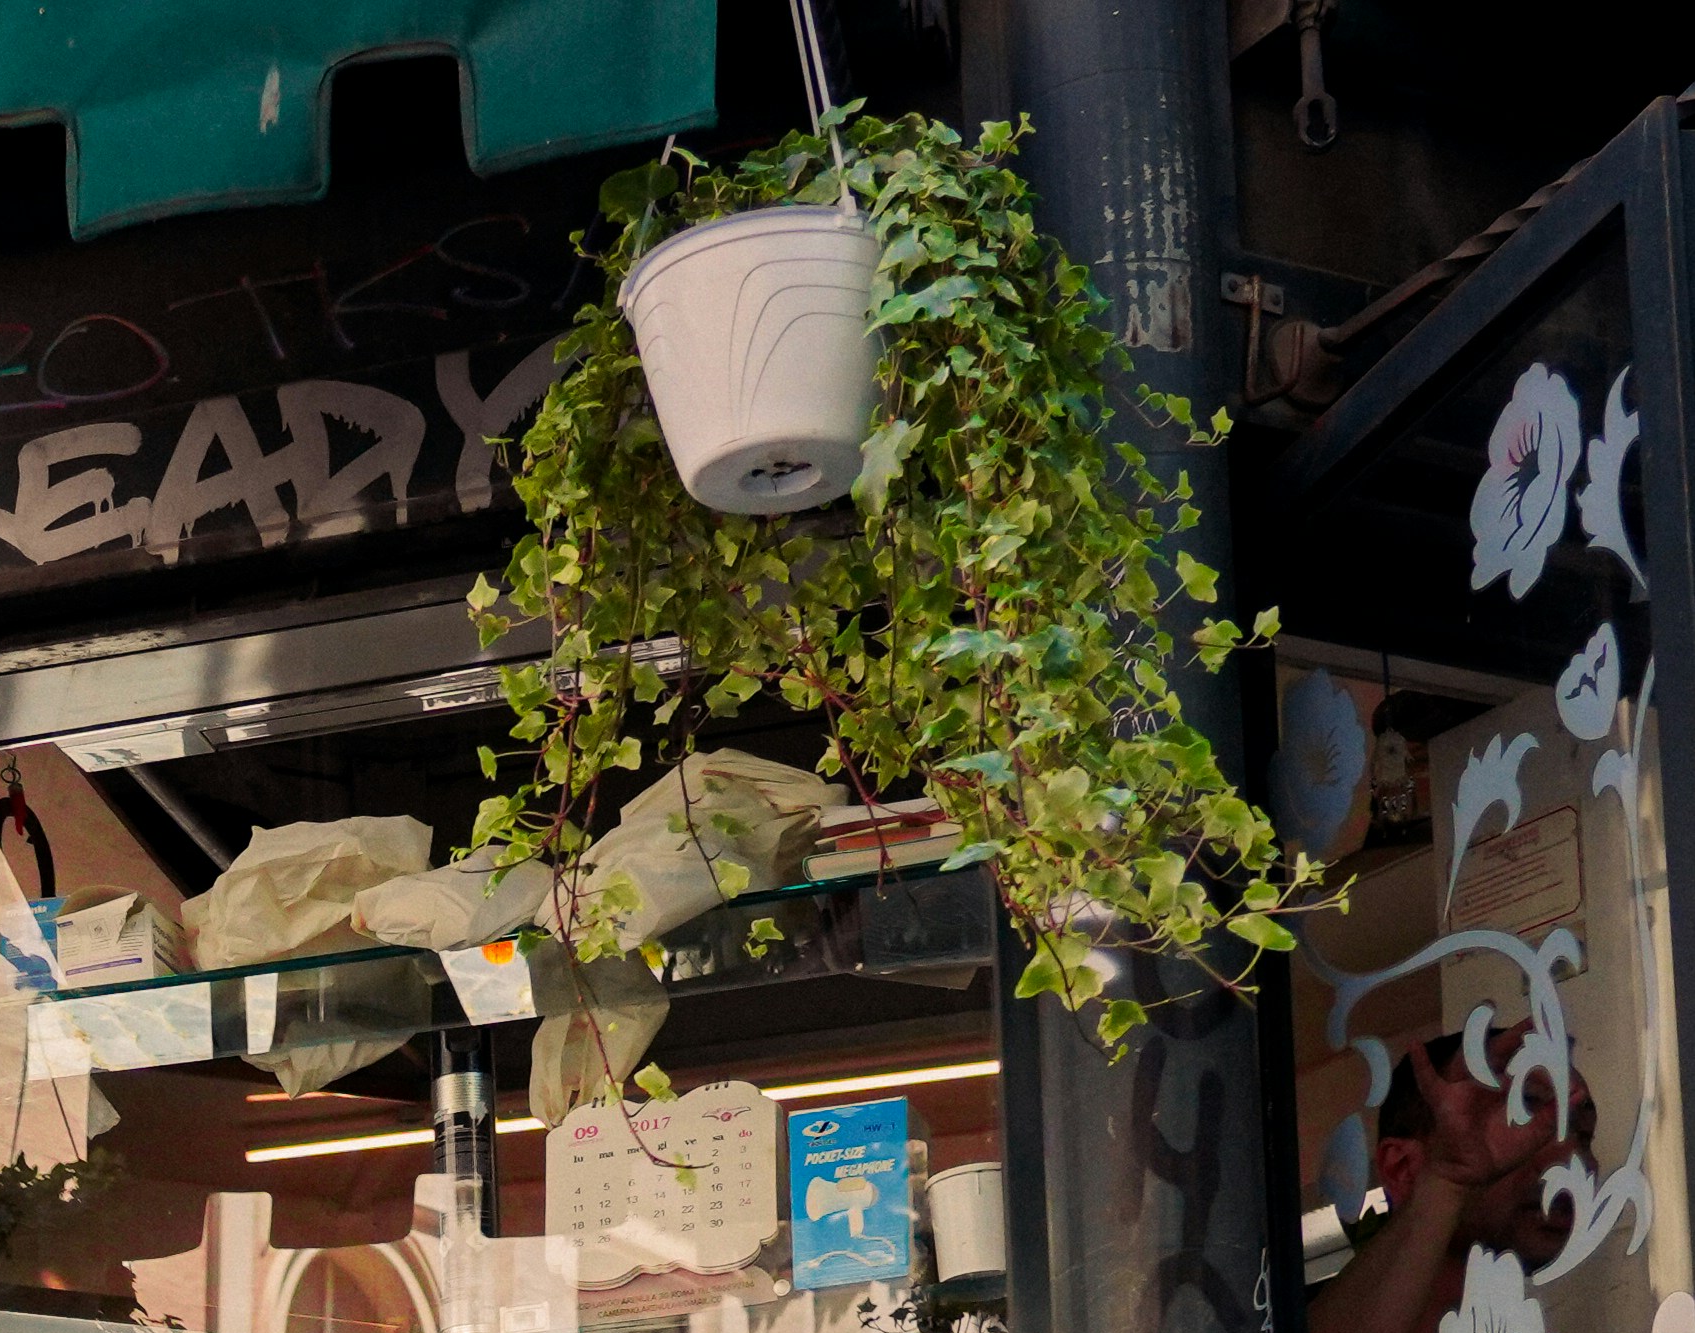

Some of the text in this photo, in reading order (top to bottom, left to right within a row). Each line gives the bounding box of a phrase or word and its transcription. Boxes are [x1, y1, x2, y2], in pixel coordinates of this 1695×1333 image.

[574, 1116, 671, 1140] 09 2017
[573, 1154, 584, 1164] lu
[599, 1150, 614, 1159] ma
[657, 1141, 668, 1151] gi
[684, 1137, 697, 1146] ve
[712, 1133, 724, 1142] sa
[738, 1129, 753, 1138] do
[712, 1149, 719, 1158] 2
[804, 1145, 866, 1166] POCKET-SIZE
[575, 1187, 581, 1196] 4
[603, 1182, 610, 1192] 5
[713, 1165, 720, 1175] 9
[740, 1162, 752, 1171] 10
[834, 1159, 896, 1179] MEGAPHONE
[573, 1204, 584, 1213] 11
[599, 1200, 611, 1209] 12
[626, 1195, 638, 1204] 13
[655, 1191, 666, 1200] 14
[711, 1183, 723, 1192] 16
[740, 1179, 752, 1188] 17
[572, 1221, 585, 1230] 18
[599, 1217, 611, 1226] 19
[653, 1209, 666, 1218] 21
[681, 1205, 694, 1214] 22
[710, 1200, 723, 1210] 23
[738, 1197, 752, 1206] 24
[572, 1238, 585, 1247] 25
[597, 1234, 611, 1243] 26
[681, 1222, 695, 1231] 29
[710, 1218, 723, 1228] 30
